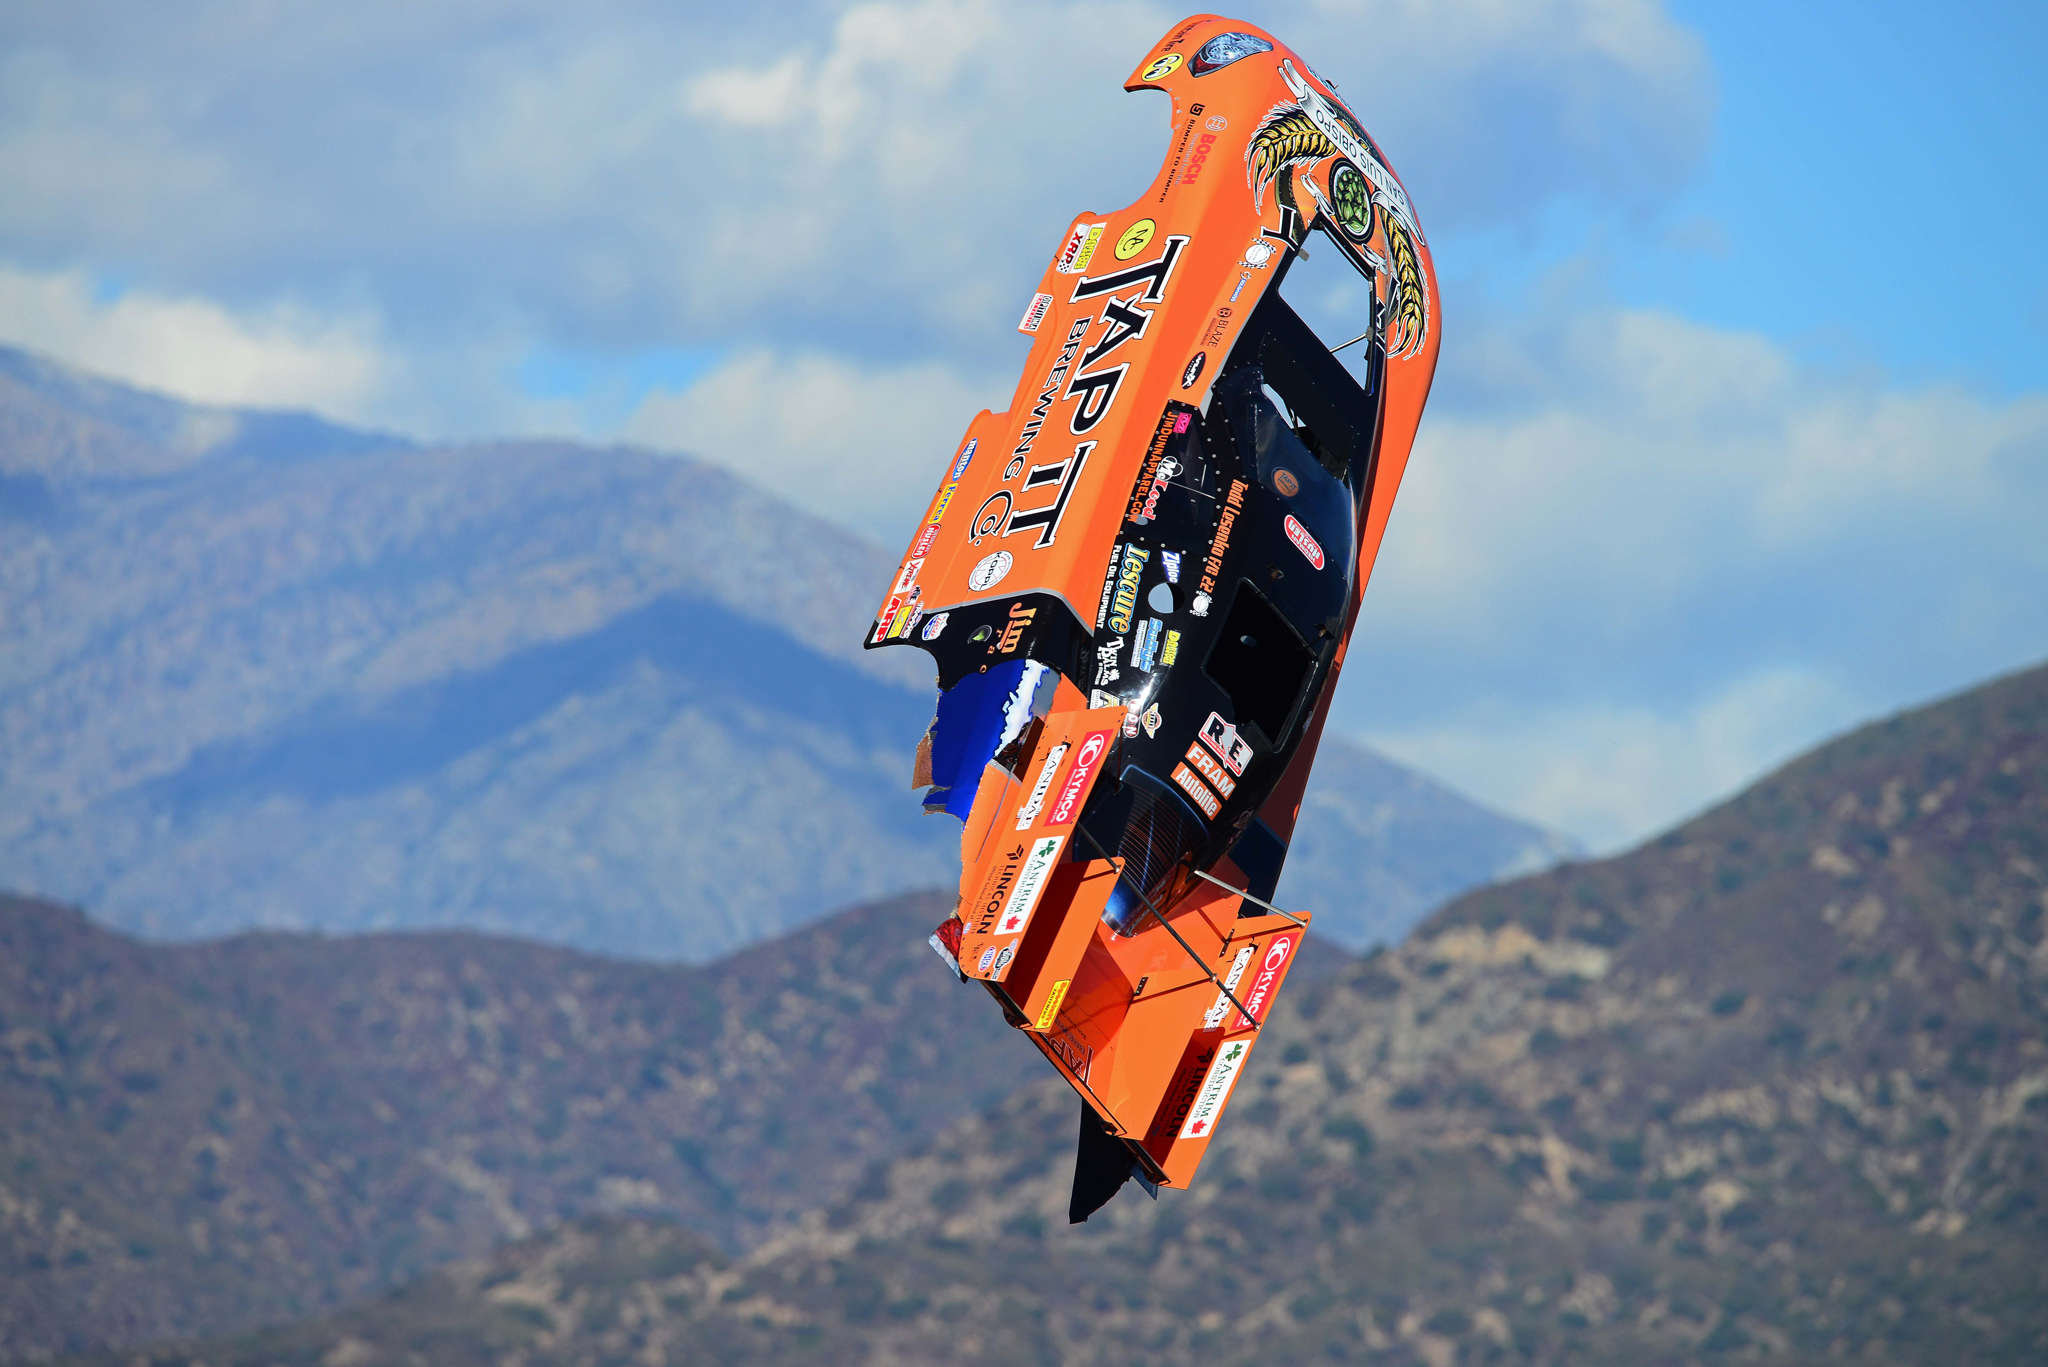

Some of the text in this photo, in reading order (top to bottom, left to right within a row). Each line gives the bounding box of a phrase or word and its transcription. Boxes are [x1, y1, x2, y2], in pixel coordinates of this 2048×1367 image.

[1173, 156, 1181, 167] TO
[1178, 118, 1196, 153] BUMPER
[1181, 133, 1217, 185] BOSCH
[1182, 132, 1201, 163] Invented
[1316, 109, 1406, 206] SAN LUIS OBISPO
[1159, 168, 1176, 203] BUMPER
[1065, 231, 1084, 264] XRP
[1028, 295, 1053, 331] OPTIMA
[1209, 319, 1229, 348] BLAZE
[1001, 235, 1191, 551] TAP IT
[1002, 314, 1094, 482] BREWING
[953, 439, 977, 479] manton
[1127, 410, 1179, 523] JIMDUNNAPPAREL.COM
[932, 485, 956, 522] Ferrea
[1226, 478, 1249, 509] Todd
[1210, 505, 1241, 558] Lesenko
[1096, 544, 1122, 629] FUEL OIL EQUIPMENT
[1109, 543, 1150, 634] Lescure
[1161, 550, 1181, 583] Ziploc
[1199, 574, 1216, 594] 22
[877, 597, 901, 642] ARP
[1001, 602, 1037, 654] Jim
[1139, 617, 1163, 673] Sully's
[1097, 645, 1111, 686] PALMS
[1106, 636, 1125, 667] TWIN
[1055, 767, 1089, 822] KYMCO
[1175, 767, 1218, 817] Autolite
[1187, 745, 1236, 797] FRAM
[976, 865, 1017, 934] LINCOLN
[1007, 854, 1038, 915] CONSTRUCTION
[1014, 860, 1046, 913] ANTRIM
[1242, 971, 1275, 1026] KYMCO
[1165, 1066, 1208, 1137] LINCOLN
[1193, 1057, 1226, 1119] CONSTRUCTION
[1200, 1063, 1233, 1117] ANTRIM
